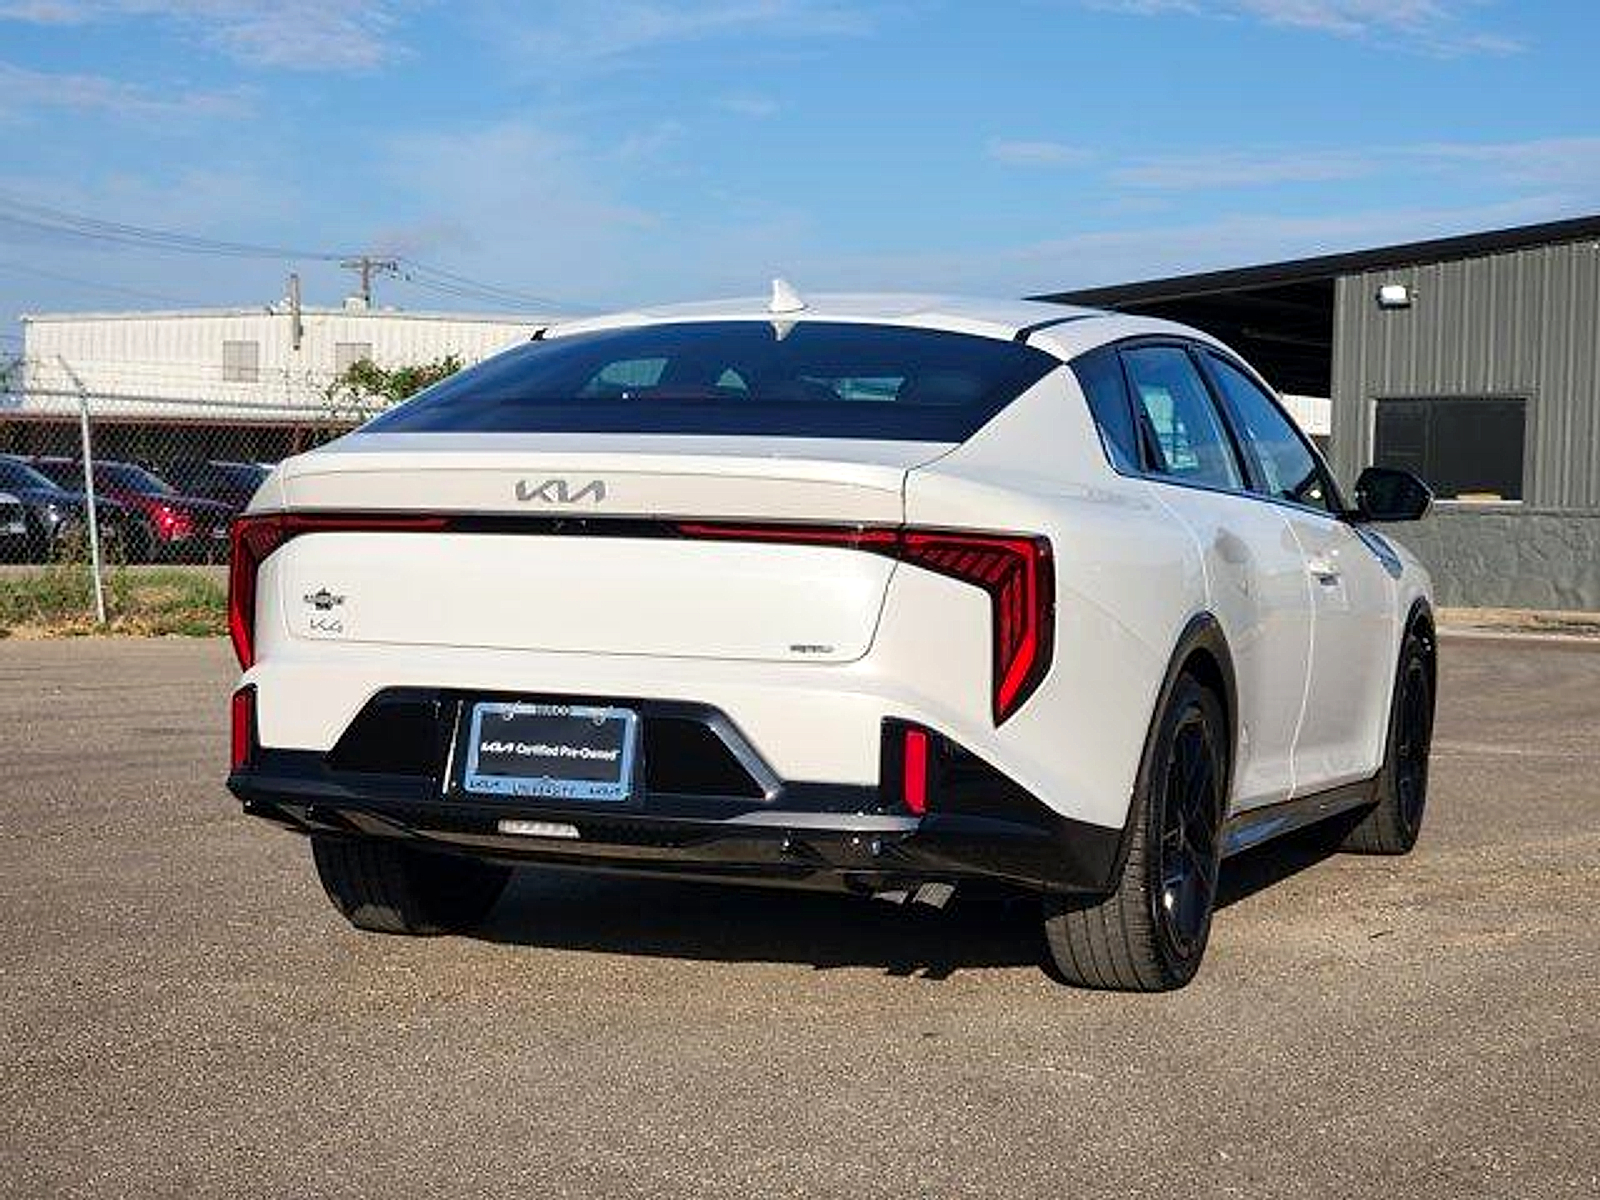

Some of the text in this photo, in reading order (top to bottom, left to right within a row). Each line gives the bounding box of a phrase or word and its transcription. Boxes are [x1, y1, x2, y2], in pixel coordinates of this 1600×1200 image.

[515, 479, 606, 503] KIA
[516, 742, 559, 756] Certified
[560, 744, 618, 761] Pre-Owned
